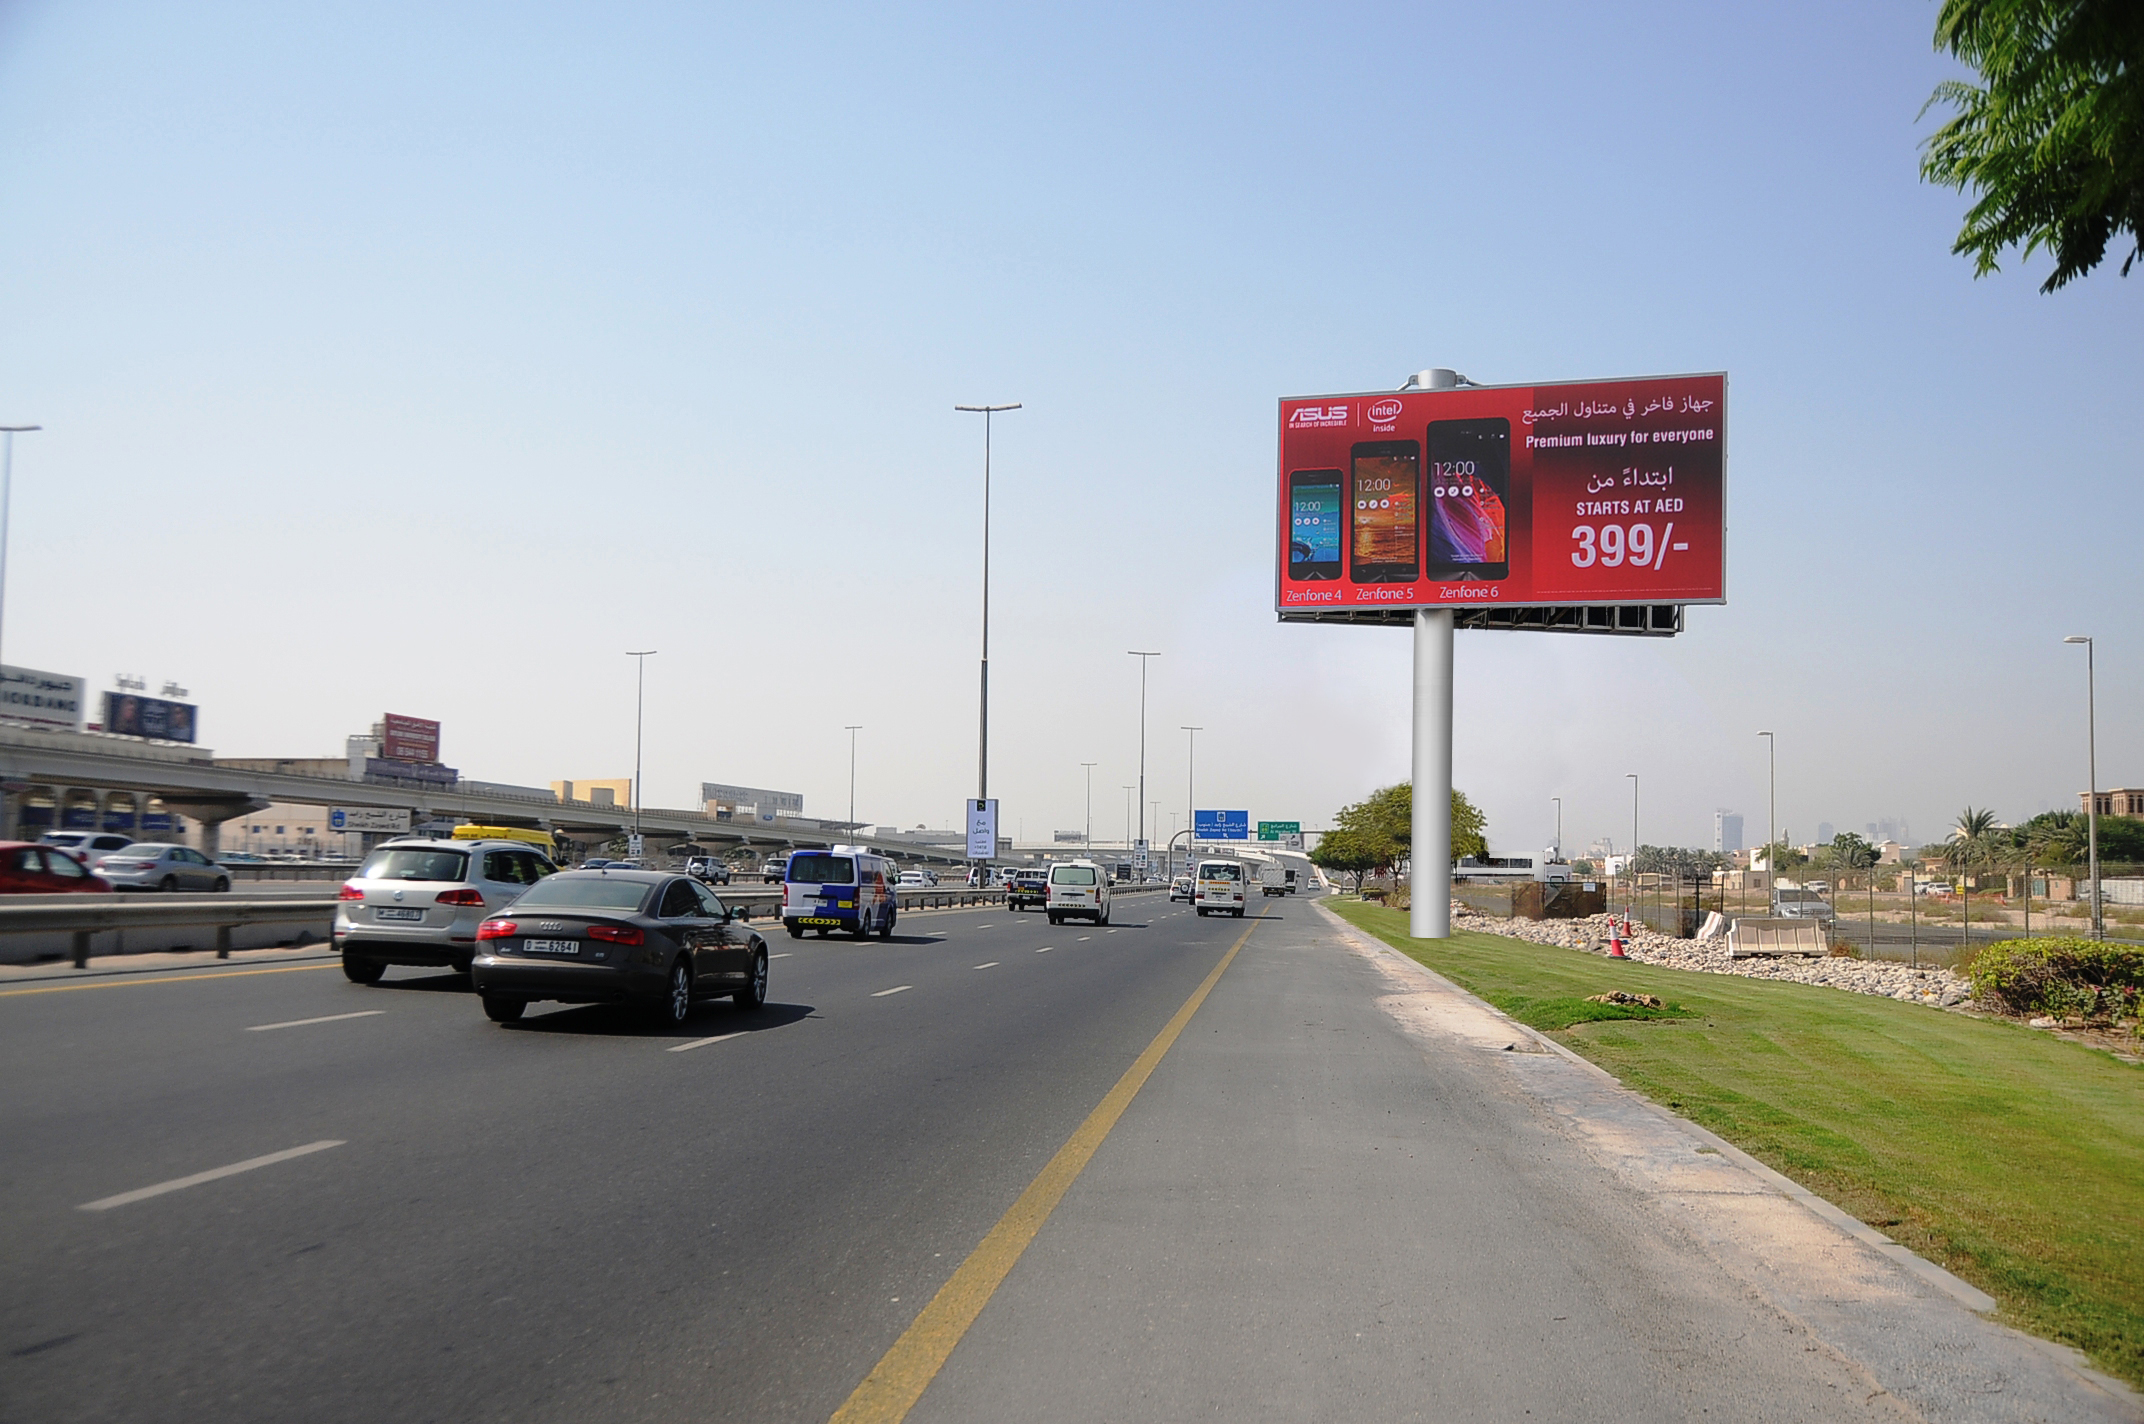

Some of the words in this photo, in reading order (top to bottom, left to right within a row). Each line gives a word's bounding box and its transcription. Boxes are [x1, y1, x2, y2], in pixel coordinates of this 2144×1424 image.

[1372, 403, 1397, 416] intel
[1573, 400, 1617, 419] متناول
[1622, 398, 1635, 419] في
[1641, 396, 1674, 416] فاخر
[1679, 394, 1714, 413] جهاز
[1289, 405, 1348, 422] ASUS
[1521, 402, 1568, 424] الجميع
[1320, 419, 1347, 427] INCREDIBLE
[1373, 424, 1395, 432] inside
[1525, 434, 1583, 448] Premium
[1587, 431, 1627, 447] luxury
[1630, 430, 1649, 443] for
[1652, 428, 1714, 445] everyone
[1434, 461, 1475, 476] 12:00
[1357, 478, 1391, 492] 12:00
[1587, 473, 1615, 494] من
[1294, 501, 1321, 512] 12:00
[1576, 501, 1629, 516] STARTS
[1633, 500, 1651, 514] AT
[1655, 498, 1684, 513] AED
[1571, 522, 1689, 570] 399/-
[1332, 590, 1342, 601] 4
[1406, 588, 1414, 599] 5
[1490, 586, 1499, 597] 6
[549, 941, 577, 952] 62641
